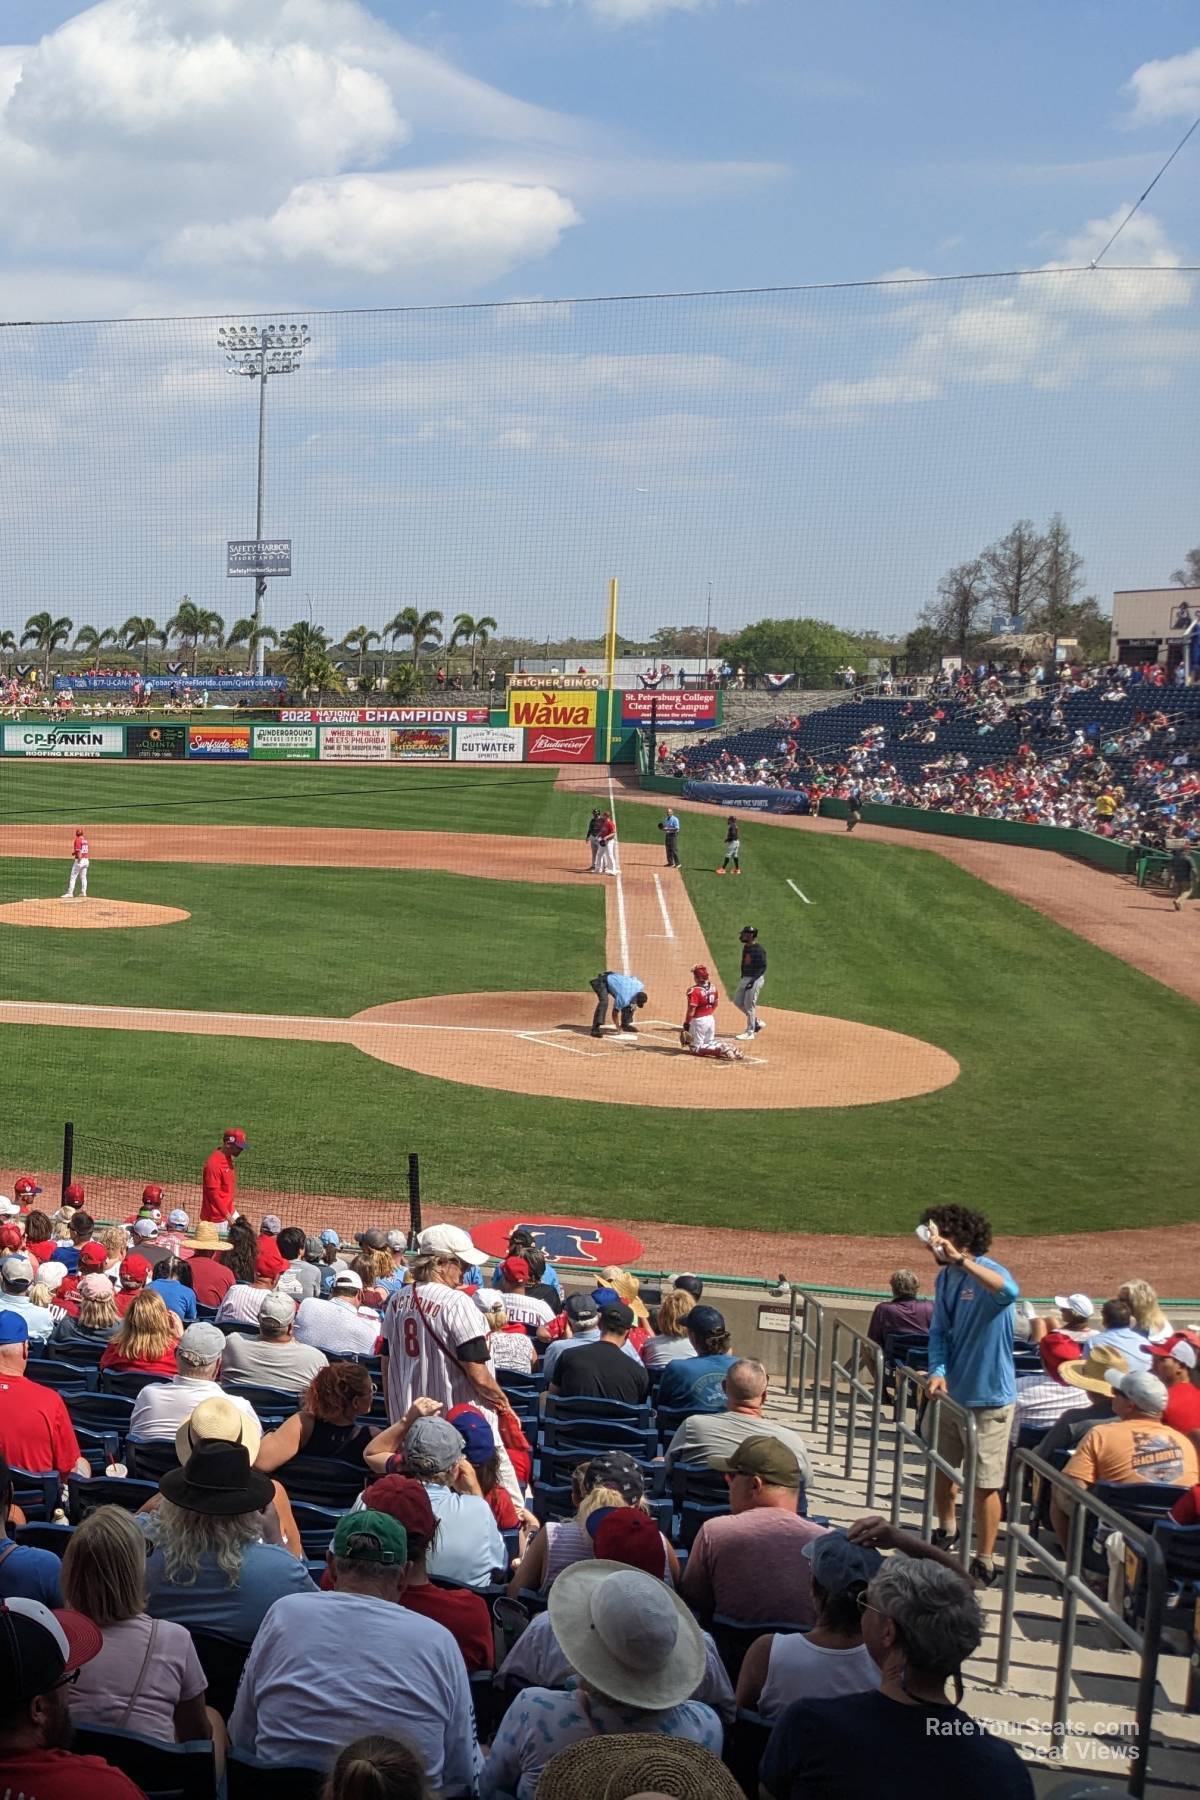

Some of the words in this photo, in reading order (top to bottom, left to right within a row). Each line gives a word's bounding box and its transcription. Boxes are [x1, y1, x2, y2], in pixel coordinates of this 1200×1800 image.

[229, 545, 256, 553] SAFETY
[509, 679, 559, 687] BELCHER
[564, 679, 599, 687] BINGO
[625, 693, 636, 701] St.
[638, 693, 681, 703] Petersburg
[682, 693, 714, 703] College
[674, 703, 709, 712] Campus
[281, 711, 311, 722] 2022
[365, 711, 467, 722] CHAMPIONS
[513, 702, 589, 725] Wawa
[24, 733, 103, 745] CP-RANKIN
[190, 735, 230, 751] Surfside
[536, 739, 584, 748] Budweiser
[142, 740, 175, 749] QUINTA
[461, 743, 515, 752] CUTWATER
[48, 1303, 68, 1320] TON
[508, 1309, 542, 1326] RLTON
[403, 1317, 419, 1358] 8
